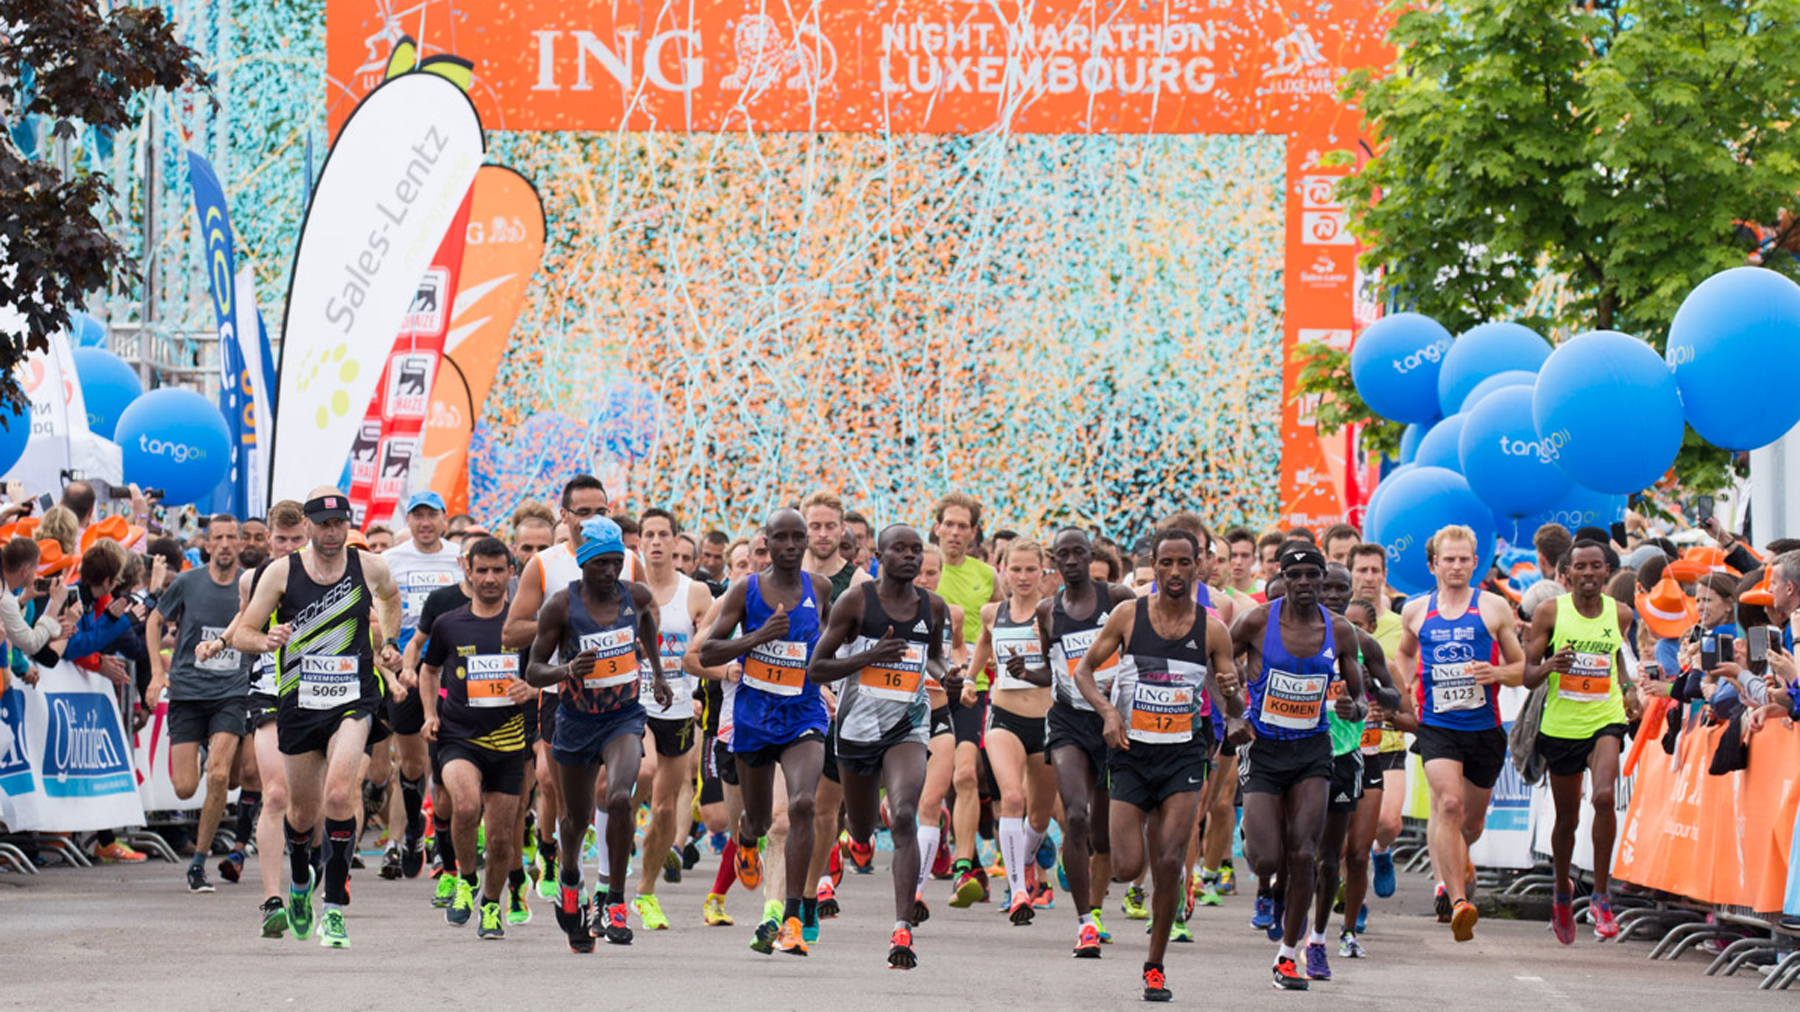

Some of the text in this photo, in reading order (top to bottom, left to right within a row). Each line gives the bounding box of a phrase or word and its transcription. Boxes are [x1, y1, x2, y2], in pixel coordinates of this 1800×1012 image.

[881, 23, 1216, 52] NIGHT MARATHON
[531, 30, 704, 91] ING
[880, 56, 1216, 95] LUXEMBOURG
[325, 124, 449, 334] Sales-Lentz
[1393, 339, 1447, 374] tango
[139, 433, 199, 463] tango
[583, 635, 614, 650] ING
[1065, 634, 1092, 652] ING
[750, 652, 802, 668] LUXEMBOURG
[1434, 644, 1473, 662] CSL
[304, 660, 336, 672] ING
[471, 658, 499, 670] ING
[608, 660, 617, 673] 3
[303, 674, 358, 683] LUXEMBOURG
[767, 667, 782, 681] 11
[884, 672, 902, 687] 16
[1434, 667, 1460, 678] ING
[312, 685, 347, 697] 5069
[489, 682, 504, 695] 15
[1274, 677, 1303, 692] ING
[1582, 679, 1590, 690] 6
[1138, 687, 1170, 703] ING
[1271, 690, 1318, 701] LUXEMBOURG
[1443, 687, 1475, 701] 4123
[1136, 702, 1189, 714] LUXEMBOURG
[1270, 700, 1316, 715] KOMEN
[1155, 716, 1173, 730] 17
[54, 698, 122, 783] Quotidien
